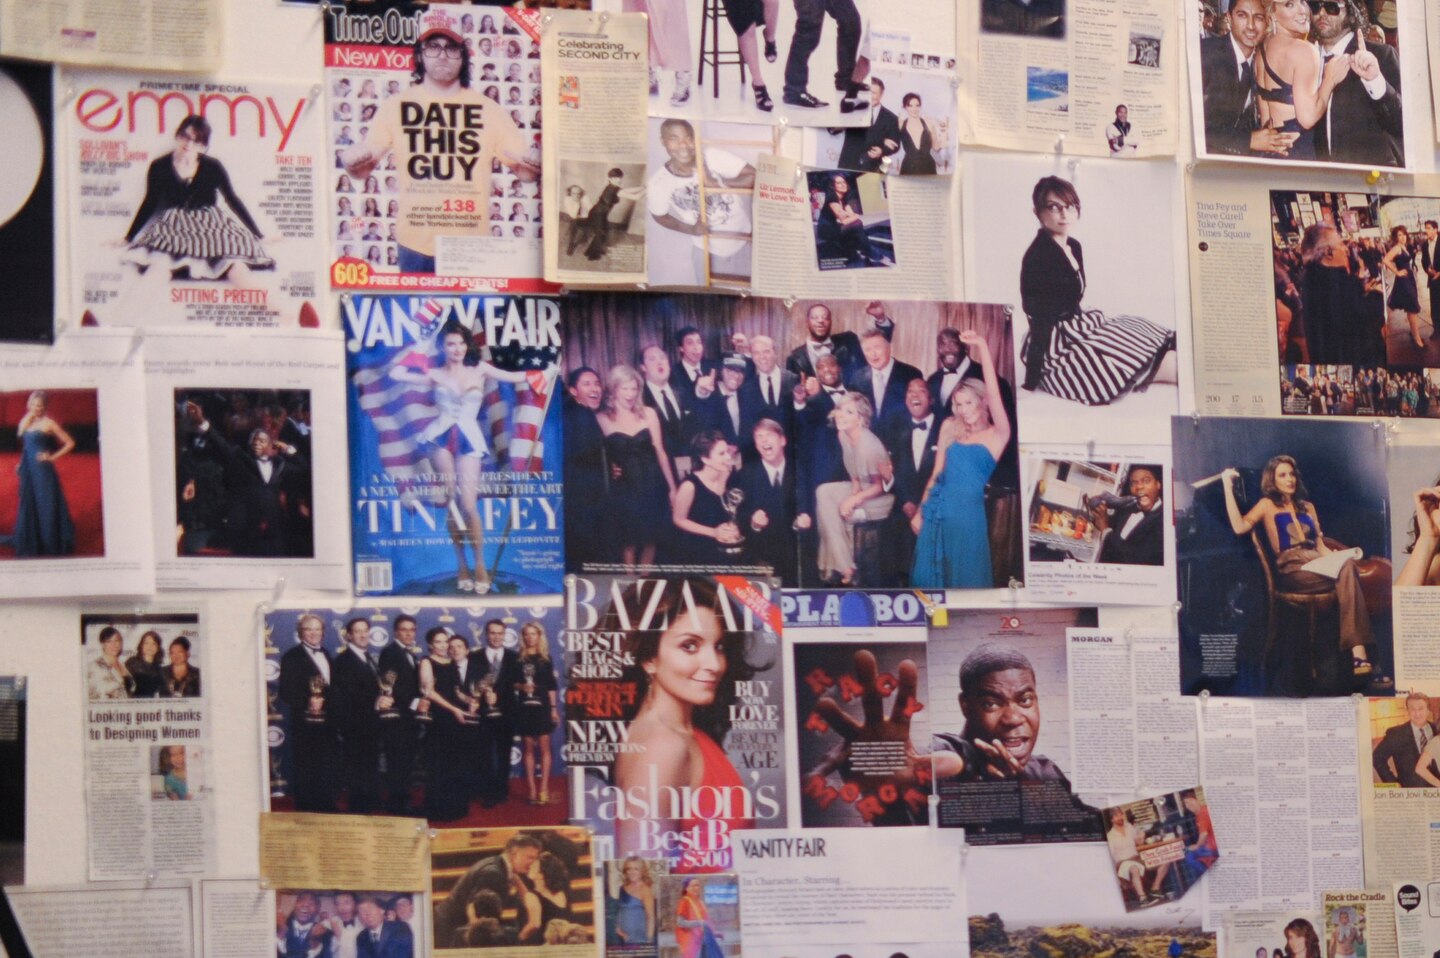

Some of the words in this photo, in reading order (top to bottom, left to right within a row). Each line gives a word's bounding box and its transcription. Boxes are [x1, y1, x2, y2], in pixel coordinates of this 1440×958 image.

[558, 39, 624, 52] Celebrating
[558, 50, 609, 60] SECOND
[611, 52, 640, 61] CITY
[334, 48, 379, 66] New
[382, 52, 412, 68] Yor
[76, 89, 305, 151] emmy
[400, 101, 483, 130] DATE
[403, 128, 481, 155] THIS
[407, 155, 479, 182] GUY
[443, 200, 475, 212] 138
[334, 265, 369, 286] 603
[369, 275, 399, 287] FREE
[400, 277, 418, 286] OR
[419, 277, 458, 286] CHEAP
[459, 278, 509, 289] EVENTS!
[484, 297, 562, 347] FAIR
[357, 500, 472, 533] TINA
[482, 497, 563, 530] FEY
[781, 593, 946, 623] PLABO
[567, 632, 627, 652] BEST
[571, 665, 623, 678] SHOES
[735, 681, 773, 697] BUY
[89, 709, 132, 725] Looking
[136, 709, 162, 725] good
[165, 709, 202, 722] thanks
[729, 706, 779, 721] LOVE
[89, 728, 100, 740] to
[105, 727, 158, 742] Designing
[162, 726, 200, 739] Women
[567, 720, 635, 743] NEW
[737, 751, 779, 768] AGE
[567, 764, 780, 820] Fashion's
[1374, 790, 1388, 799] Jon
[1389, 790, 1404, 798] Bon
[1406, 790, 1421, 799] Jovi
[639, 820, 703, 850] Best
[742, 838, 793, 858] VANITY
[796, 838, 826, 857] FAIR
